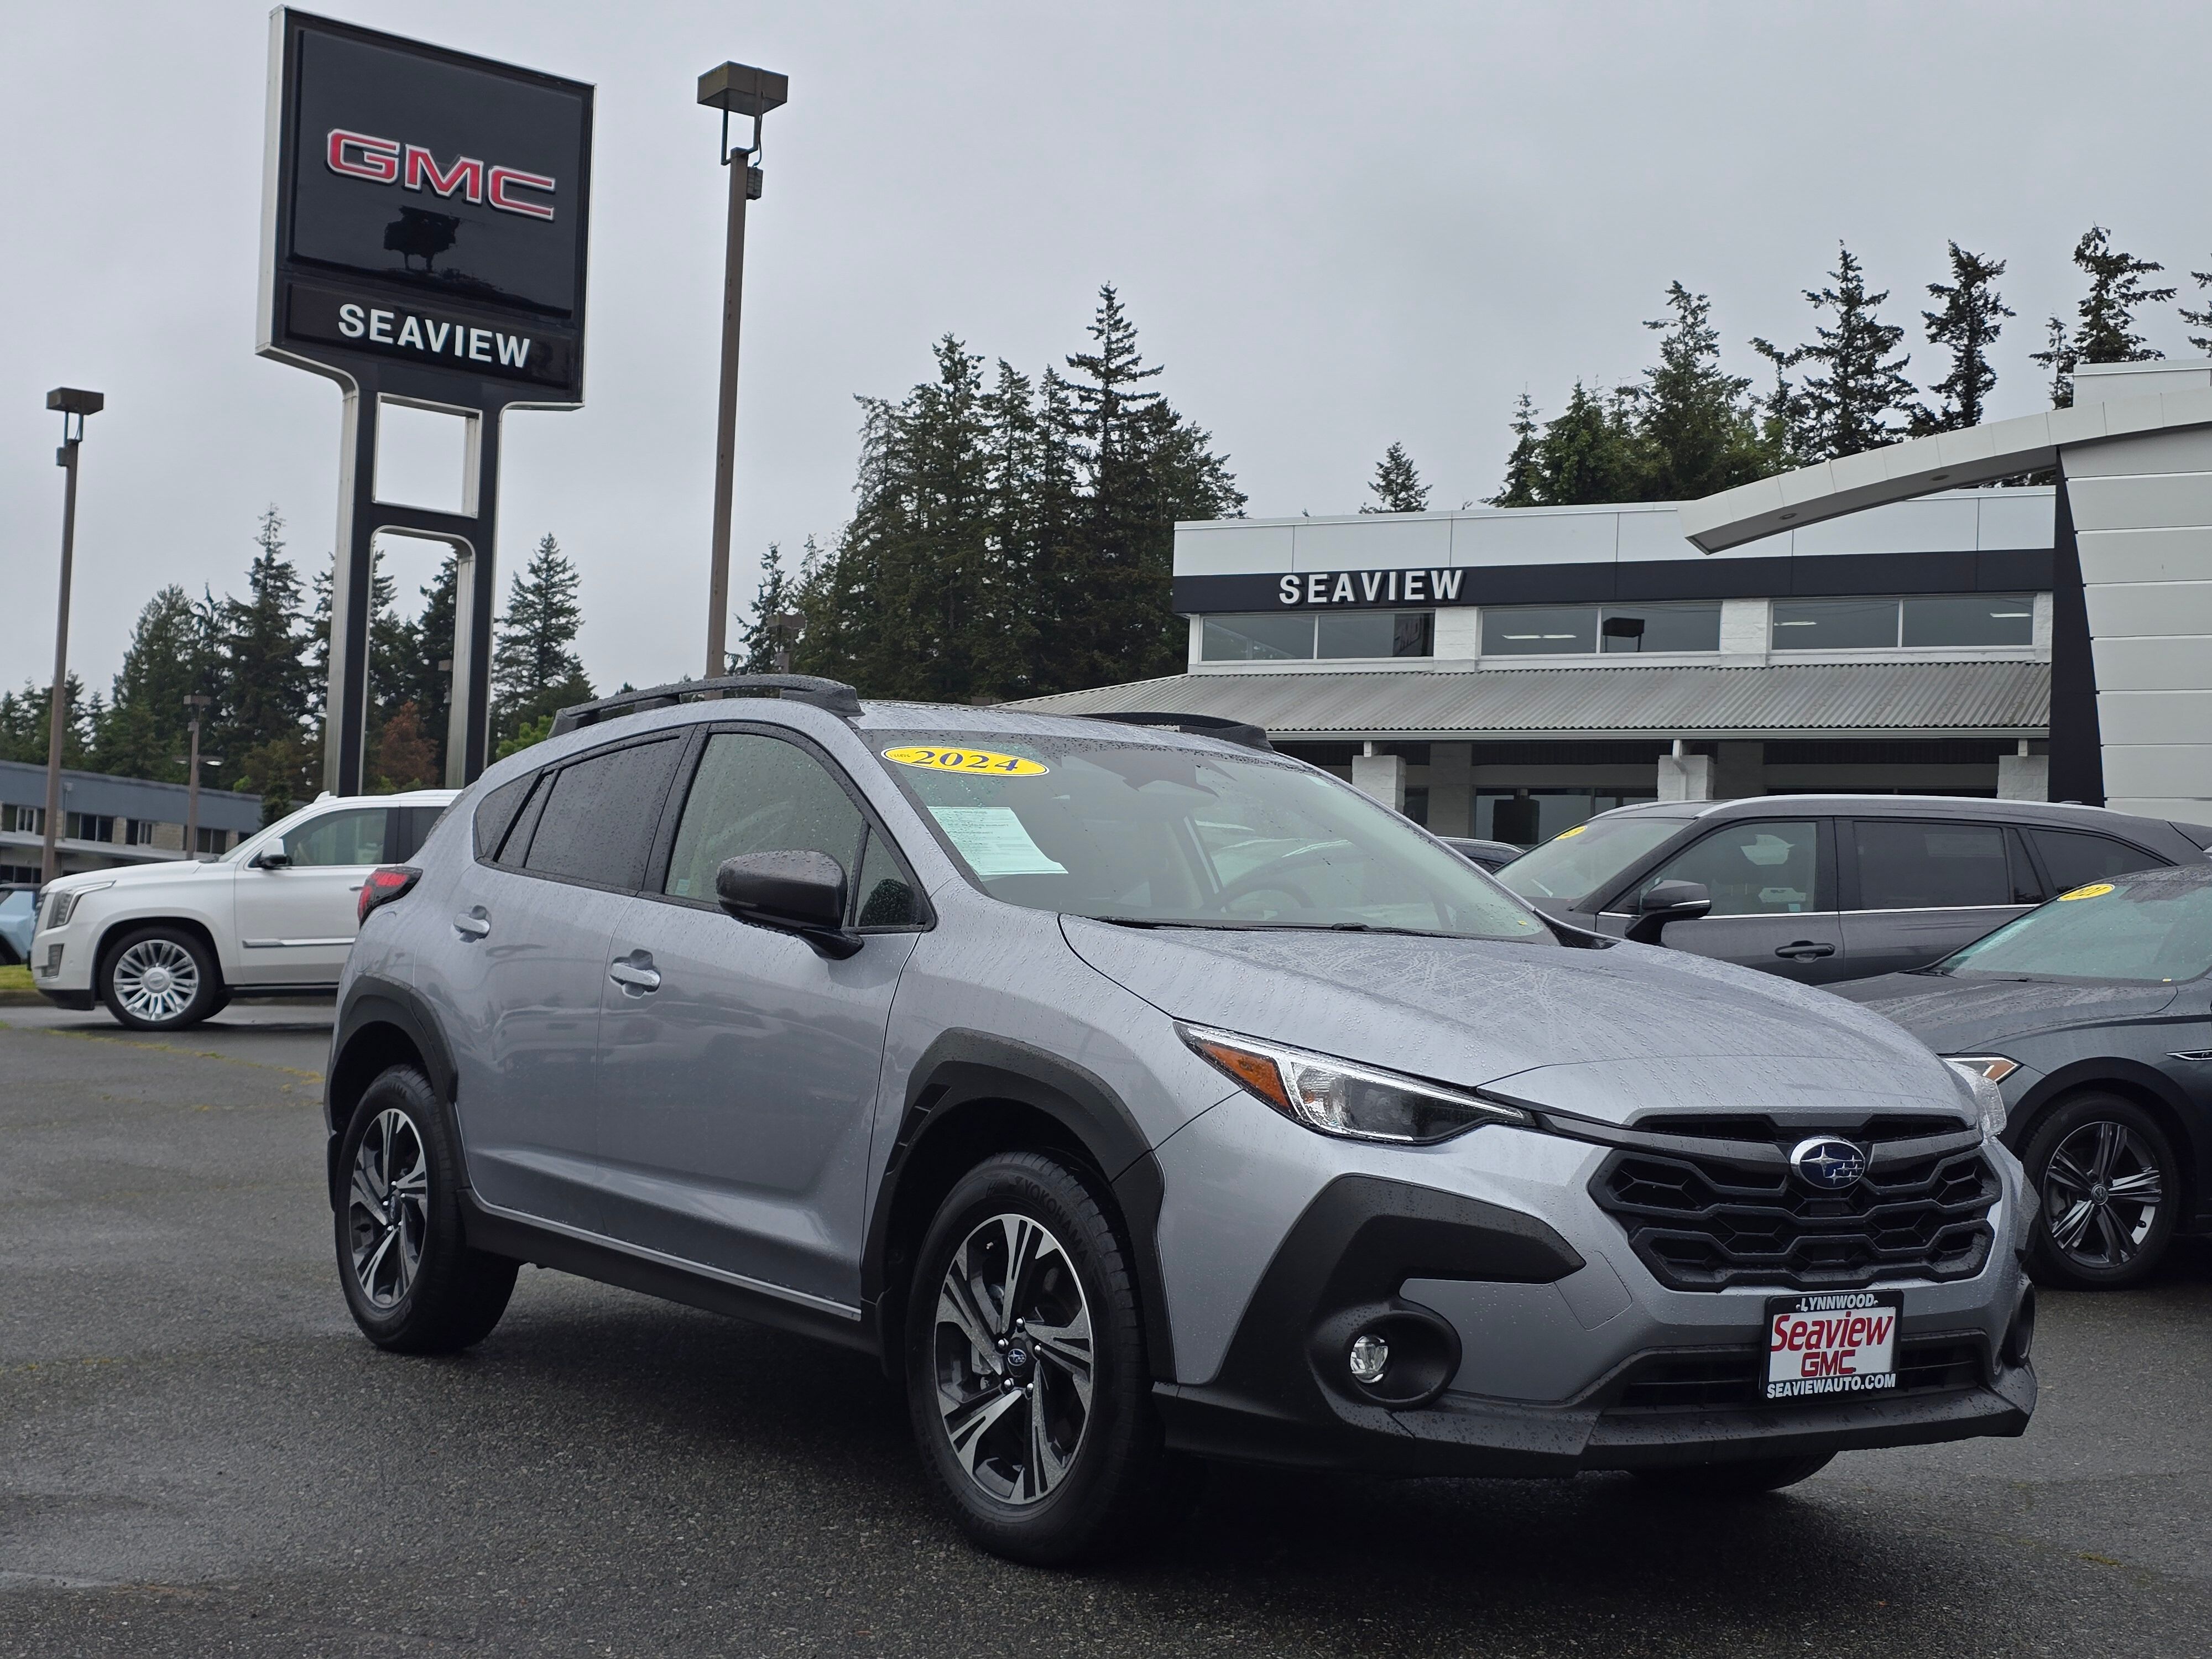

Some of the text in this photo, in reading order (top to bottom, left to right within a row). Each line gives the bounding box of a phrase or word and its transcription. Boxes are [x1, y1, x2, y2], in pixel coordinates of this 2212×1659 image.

[327, 128, 555, 221] GMC
[338, 303, 530, 368] SEAVIEW
[1279, 569, 1464, 605] SEAVIEW
[911, 750, 1019, 772] 2024
[1024, 1178, 1088, 1265] YOKOHAMA
[1800, 1293, 1875, 1312] LYNNWOOD
[1770, 1311, 1893, 1352] Seaview
[1801, 1349, 1856, 1378] GMC
[1766, 1373, 1896, 1399] SEAVIEWAUTO.COM
